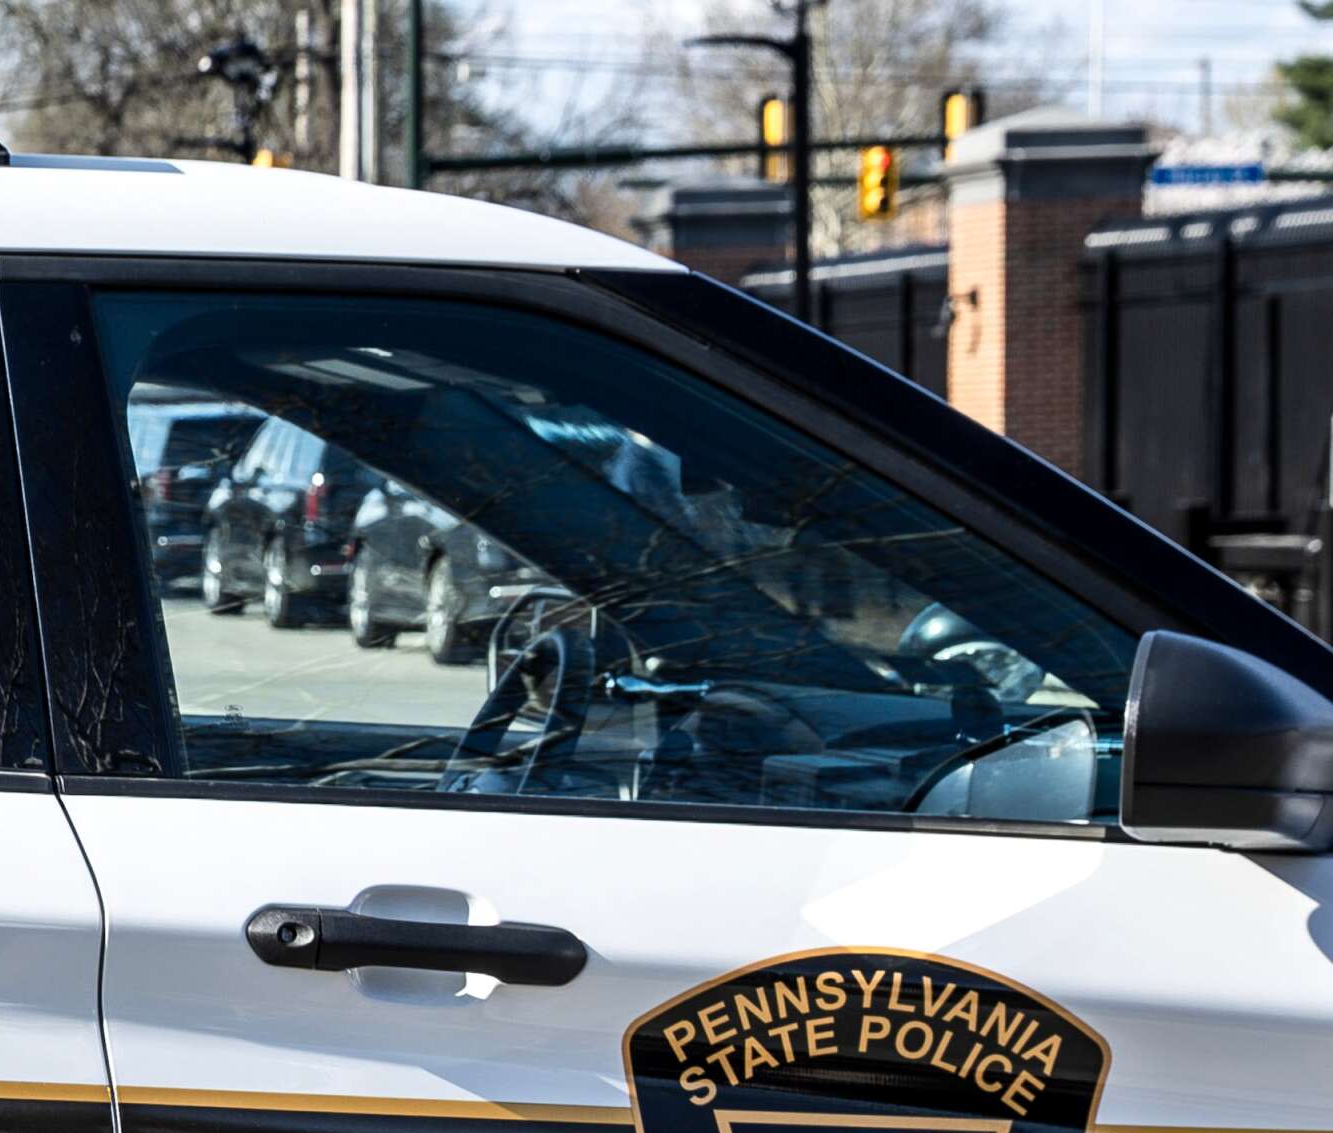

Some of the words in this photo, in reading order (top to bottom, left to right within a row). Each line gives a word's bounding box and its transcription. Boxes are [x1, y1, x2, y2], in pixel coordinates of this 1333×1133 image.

[663, 969, 1063, 1077] PENNSYLVANIA
[679, 1015, 839, 1107] STATE
[858, 1015, 1046, 1116] POLICE
